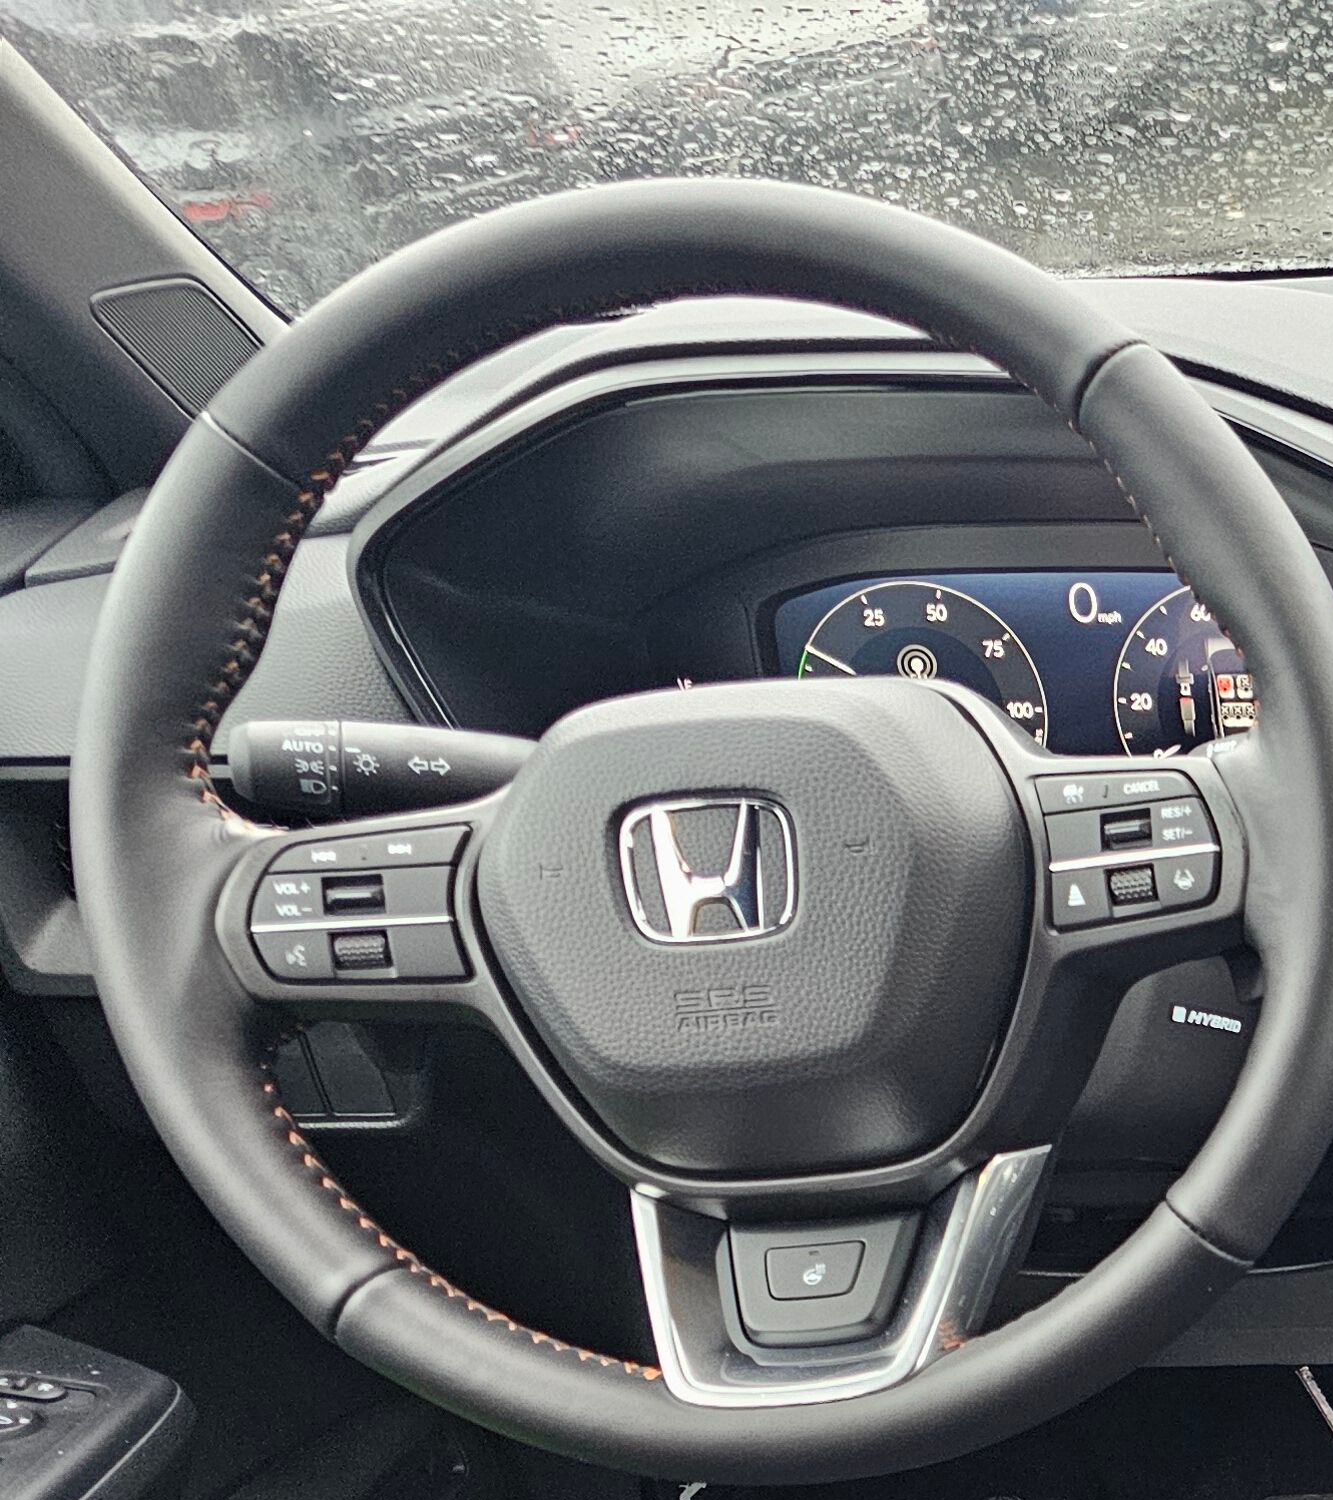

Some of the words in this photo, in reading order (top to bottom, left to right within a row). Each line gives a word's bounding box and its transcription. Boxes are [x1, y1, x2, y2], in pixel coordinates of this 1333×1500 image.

[1068, 582, 1098, 624] 0
[1098, 611, 1122, 624] mph
[863, 609, 885, 627] 25
[926, 603, 948, 622] 50
[982, 639, 1005, 658] 75
[1145, 638, 1168, 656] 40
[1006, 701, 1034, 719] 100
[1130, 692, 1153, 711] 20
[282, 739, 324, 754] AUTO
[1123, 780, 1160, 795] CANCEL
[1187, 1010, 1242, 1033] HYBRID
